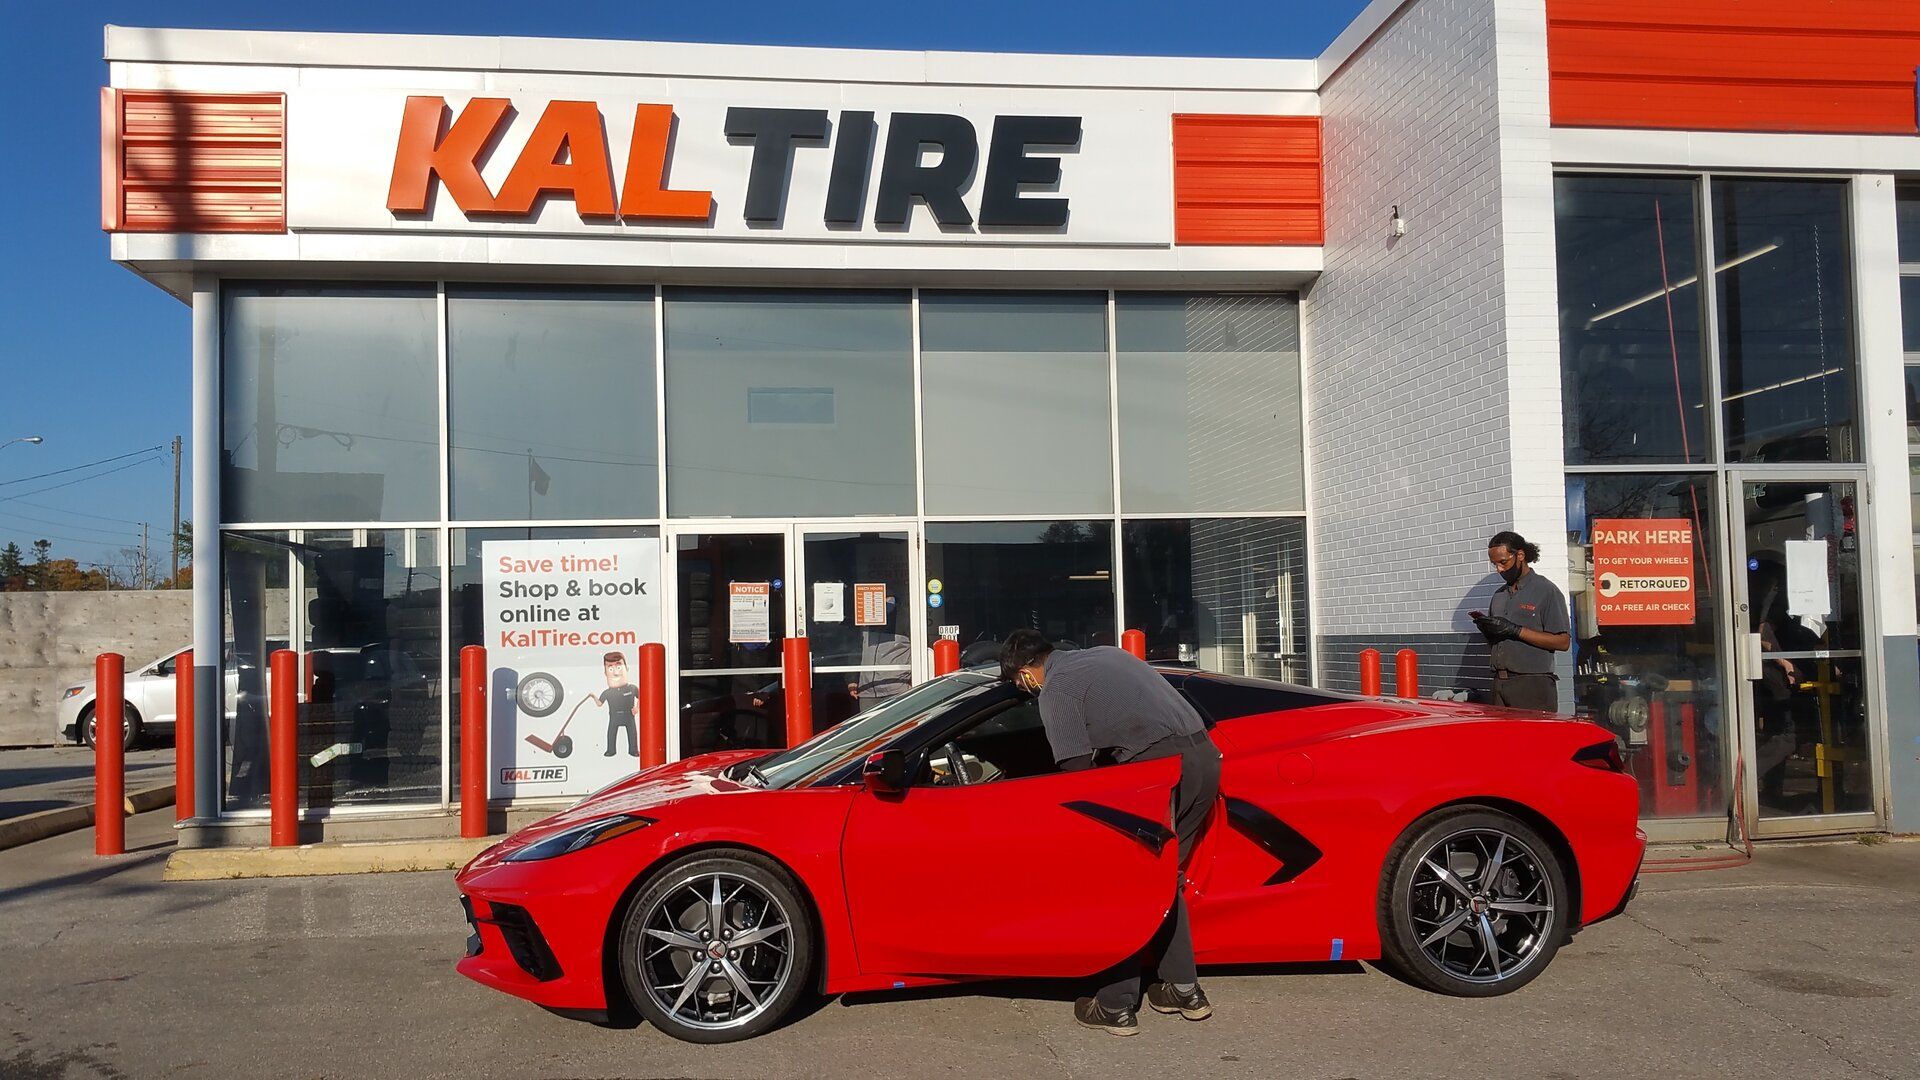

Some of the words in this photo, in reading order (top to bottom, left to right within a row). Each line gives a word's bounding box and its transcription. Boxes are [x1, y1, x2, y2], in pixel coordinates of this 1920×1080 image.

[1594, 530, 1640, 544] PARK
[1645, 530, 1692, 544] HERE
[499, 556, 553, 573] Save
[560, 554, 619, 571] time!
[1598, 557, 1609, 565] TO
[1611, 557, 1627, 565] GET
[1629, 557, 1652, 565] YOUR
[1655, 557, 1689, 565] WHEELS
[499, 580, 559, 600] Shop
[565, 579, 581, 596] &
[589, 578, 647, 596] book
[1620, 579, 1688, 588] RETORQUED
[500, 604, 571, 623] online
[577, 604, 600, 620] at
[1623, 603, 1644, 611] FREE
[1646, 603, 1660, 611] AIR
[1661, 603, 1690, 611] CHECK
[939, 626, 959, 635] DROP
[500, 630, 636, 648] KalTire.com
